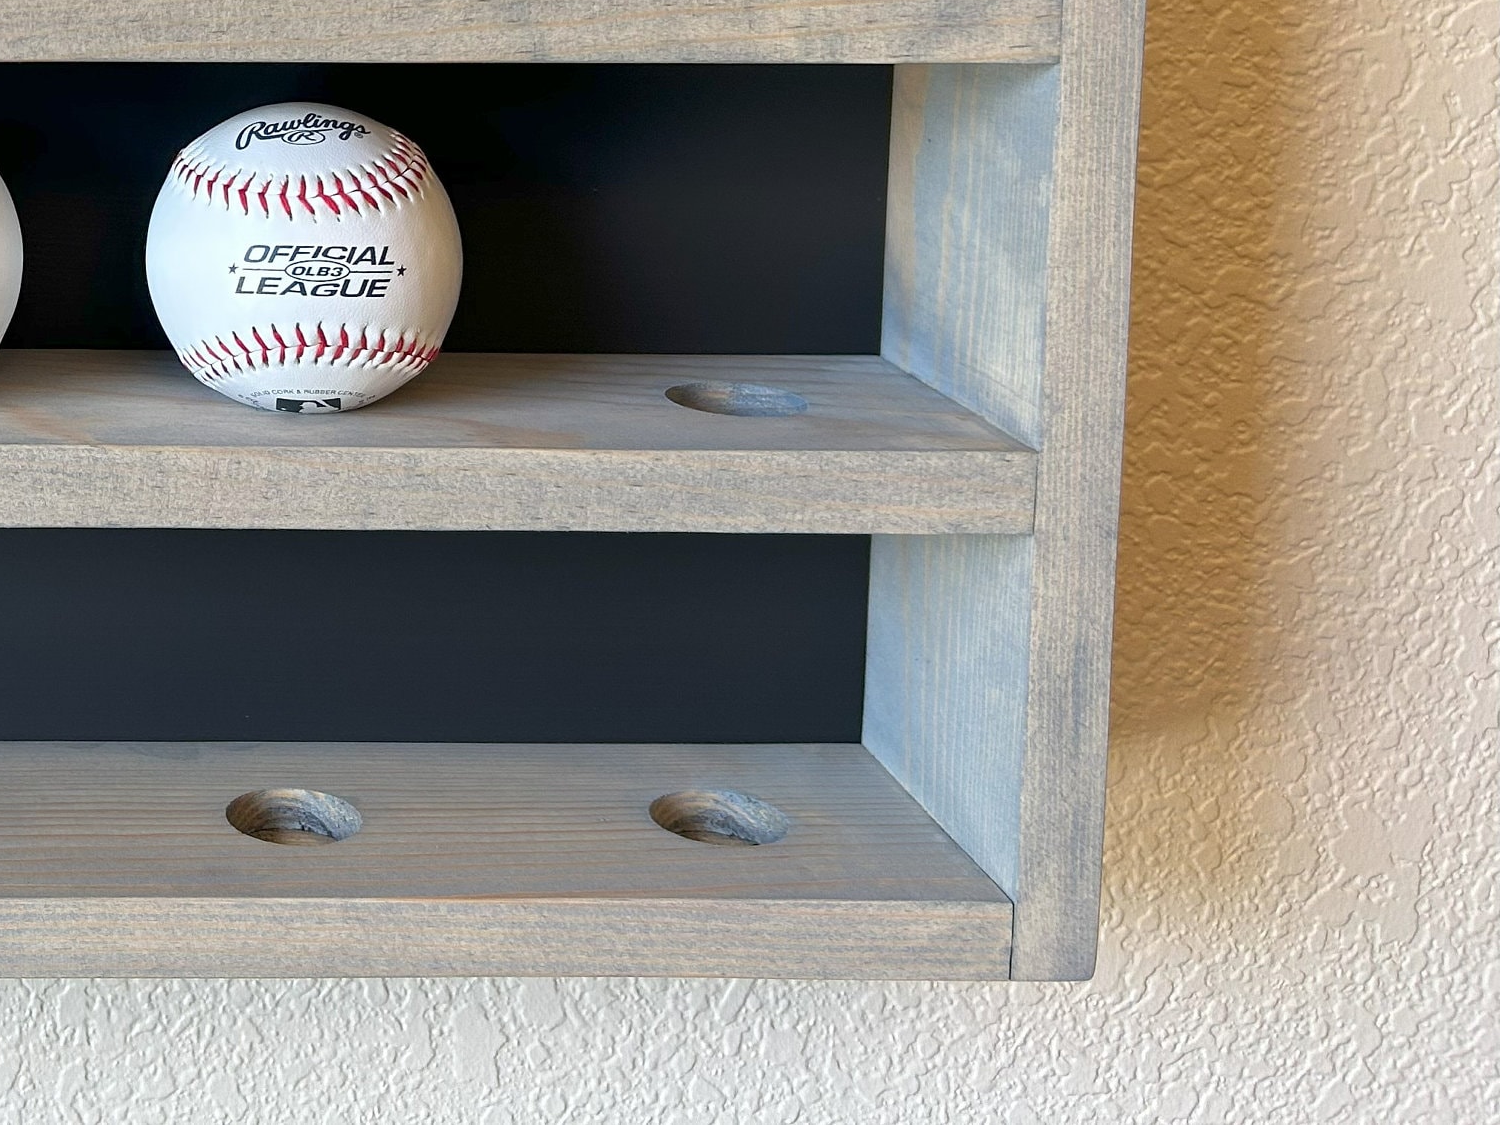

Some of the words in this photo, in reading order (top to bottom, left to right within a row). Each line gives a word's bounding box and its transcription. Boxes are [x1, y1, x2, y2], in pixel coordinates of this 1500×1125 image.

[235, 113, 371, 150] Rawlings
[244, 245, 395, 266] OFFICIAL
[291, 265, 343, 277] OLB3
[235, 276, 391, 298] LEAGUE
